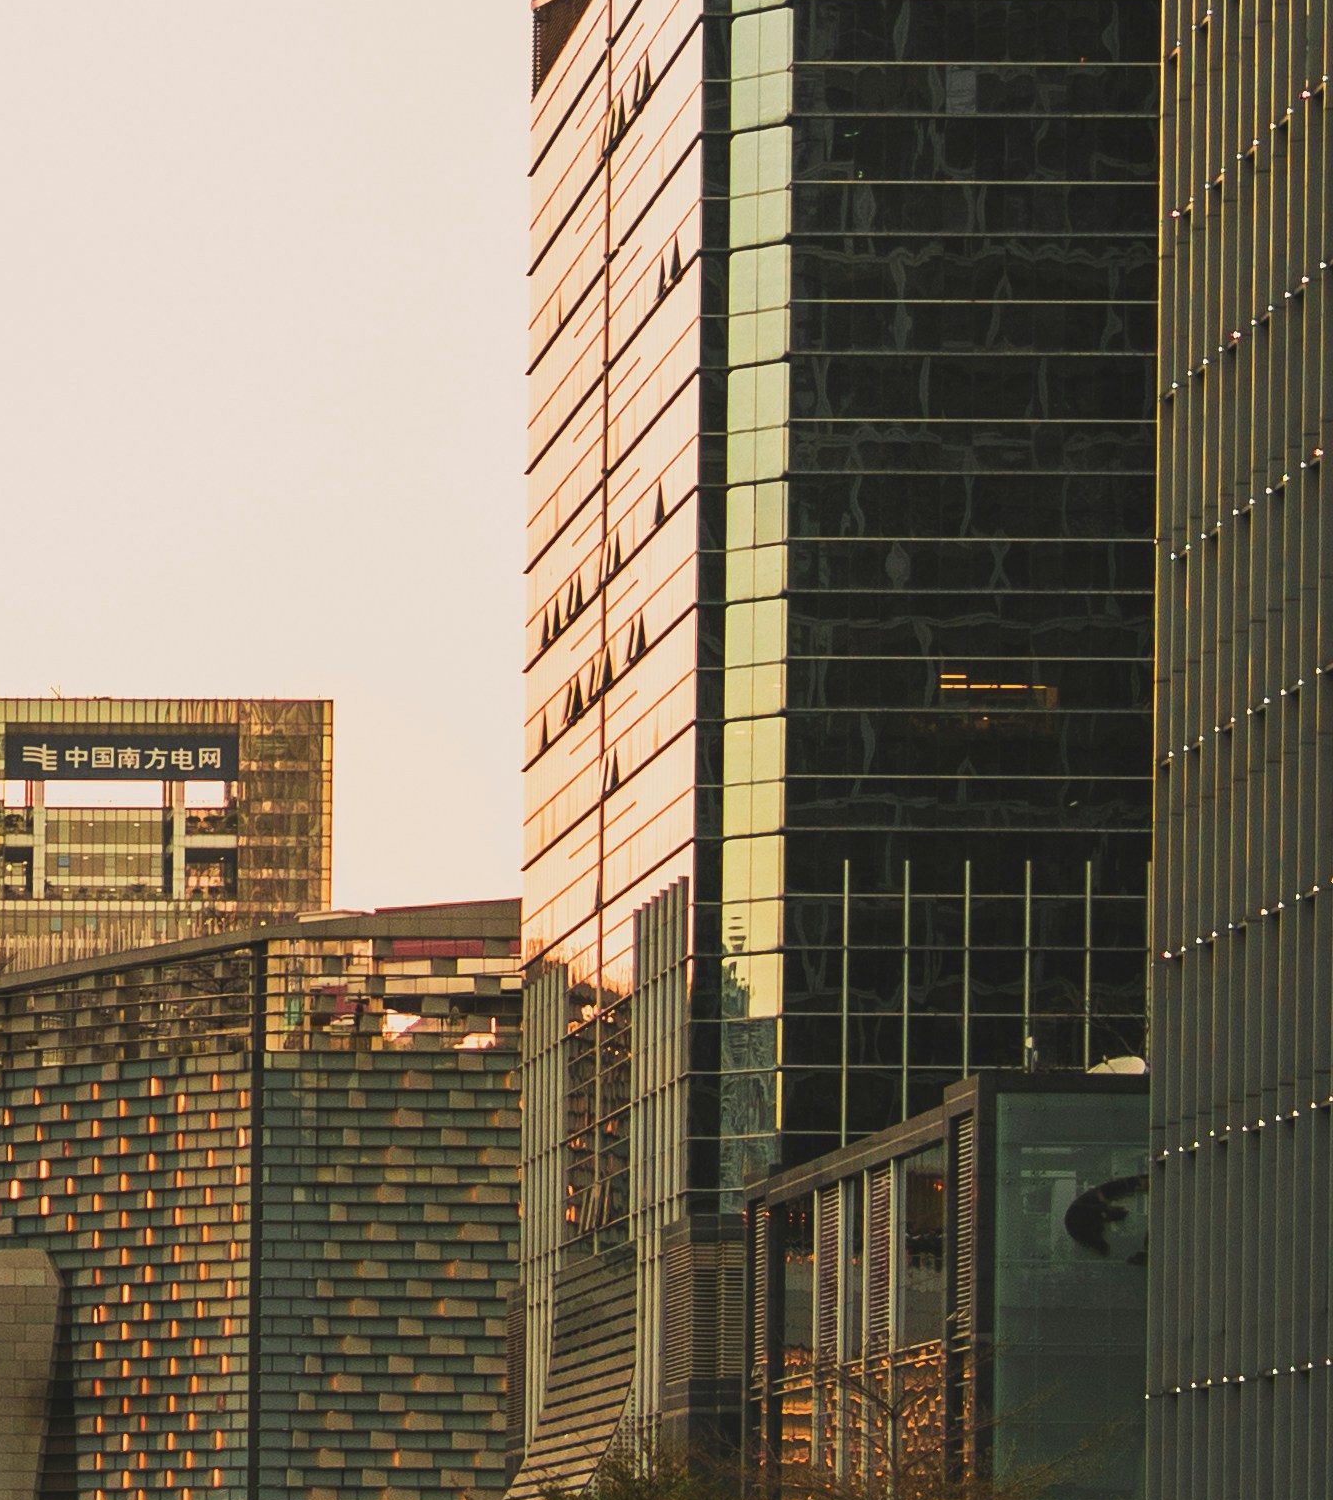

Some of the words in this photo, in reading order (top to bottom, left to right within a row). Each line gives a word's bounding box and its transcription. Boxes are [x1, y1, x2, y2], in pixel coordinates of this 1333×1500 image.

[64, 745, 221, 771] 中国南方电网
